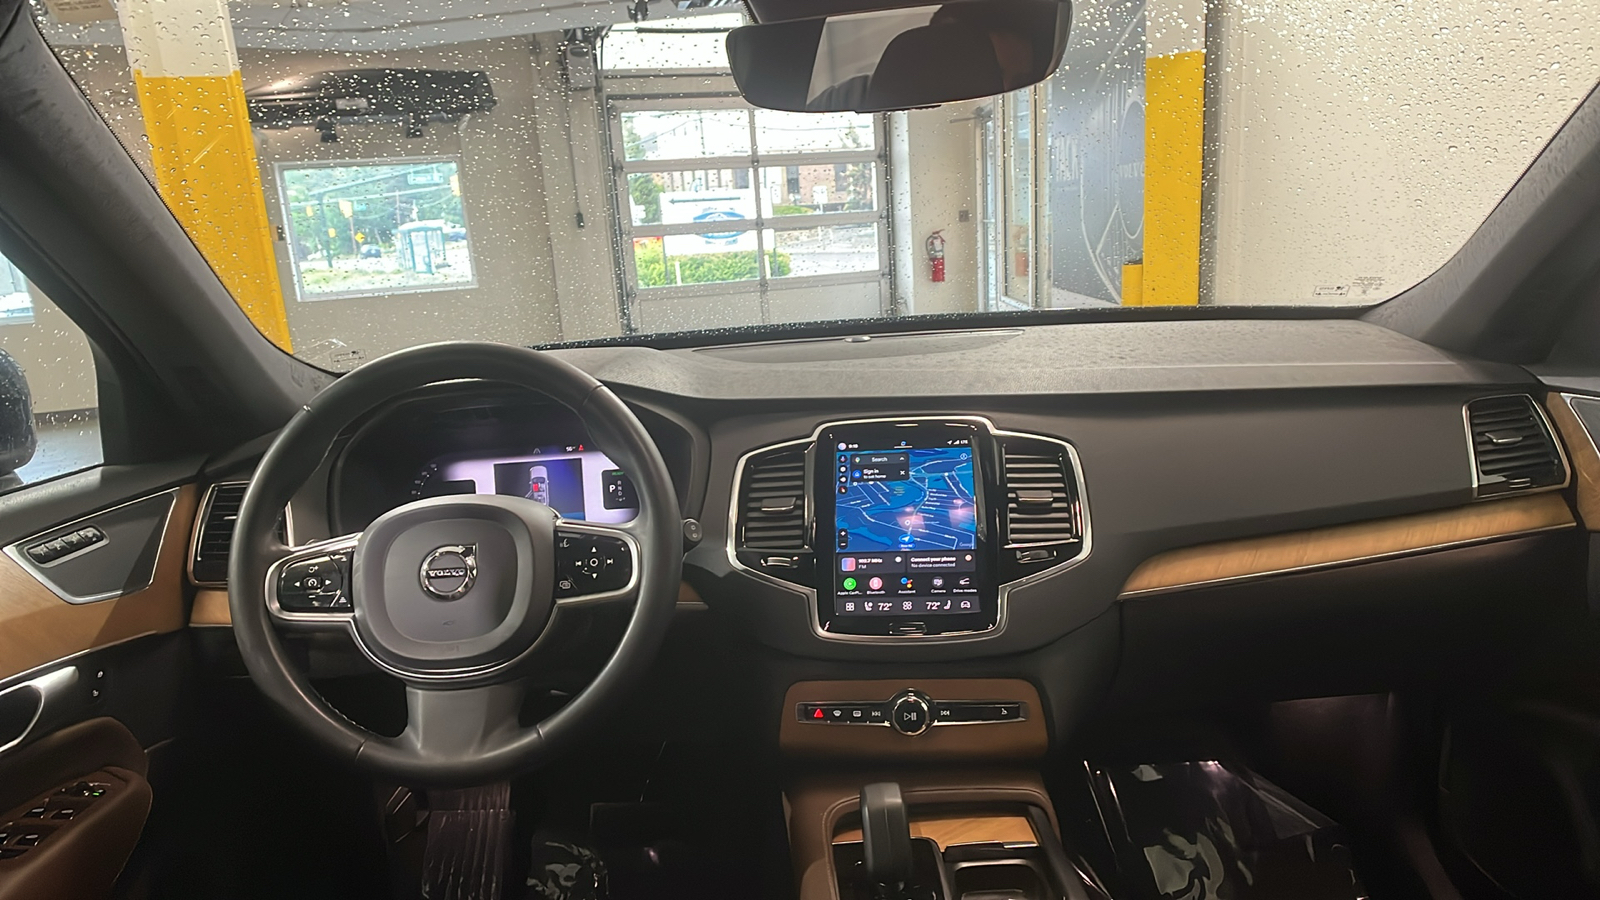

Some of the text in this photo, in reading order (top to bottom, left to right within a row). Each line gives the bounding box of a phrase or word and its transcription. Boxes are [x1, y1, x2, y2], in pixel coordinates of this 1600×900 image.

[609, 484, 616, 493] P
[428, 569, 465, 577] VOLVO
[878, 602, 893, 611] 72°
[926, 601, 941, 610] 72°
